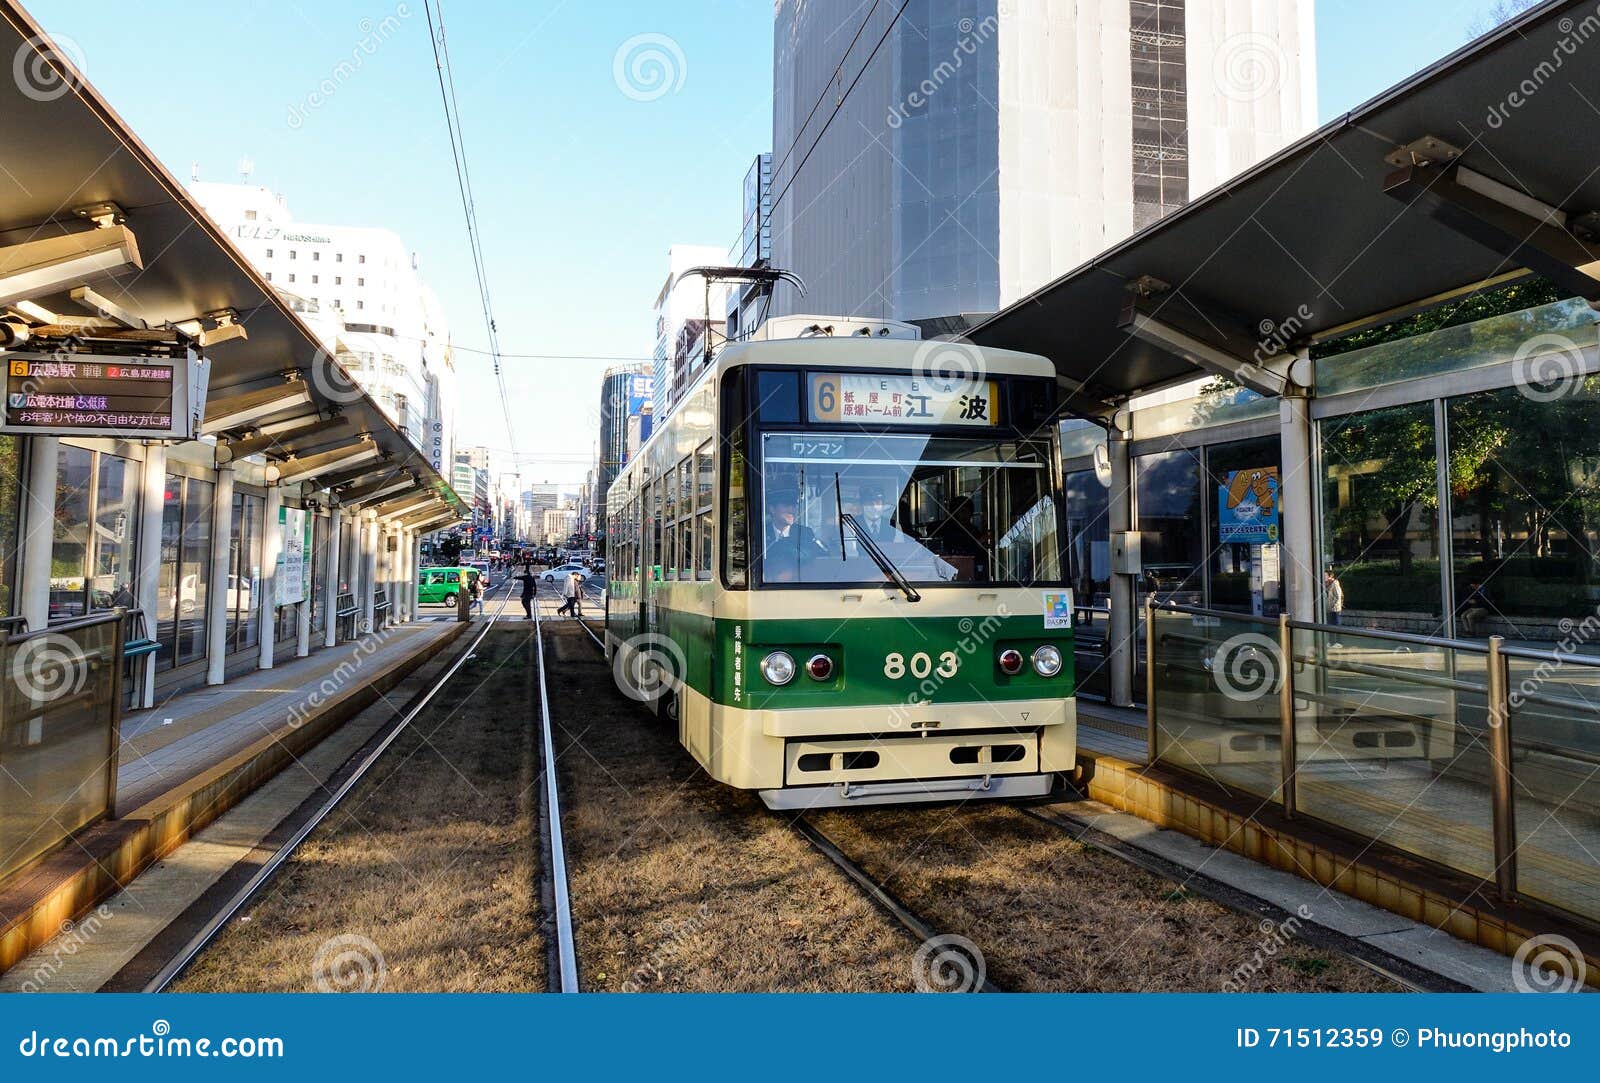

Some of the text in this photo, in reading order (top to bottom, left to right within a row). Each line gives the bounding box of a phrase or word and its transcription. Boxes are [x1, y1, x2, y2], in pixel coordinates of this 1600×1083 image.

[14, 362, 24, 375] 6
[29, 362, 76, 377] 広島駅
[26, 395, 75, 409] 広電本社前
[818, 381, 835, 413] 6
[843, 404, 903, 417] 原爆ドーム前
[20, 411, 171, 426] お年寄りや体の不自由な方に席
[793, 443, 842, 454] ワンマン
[884, 651, 958, 679] 803
